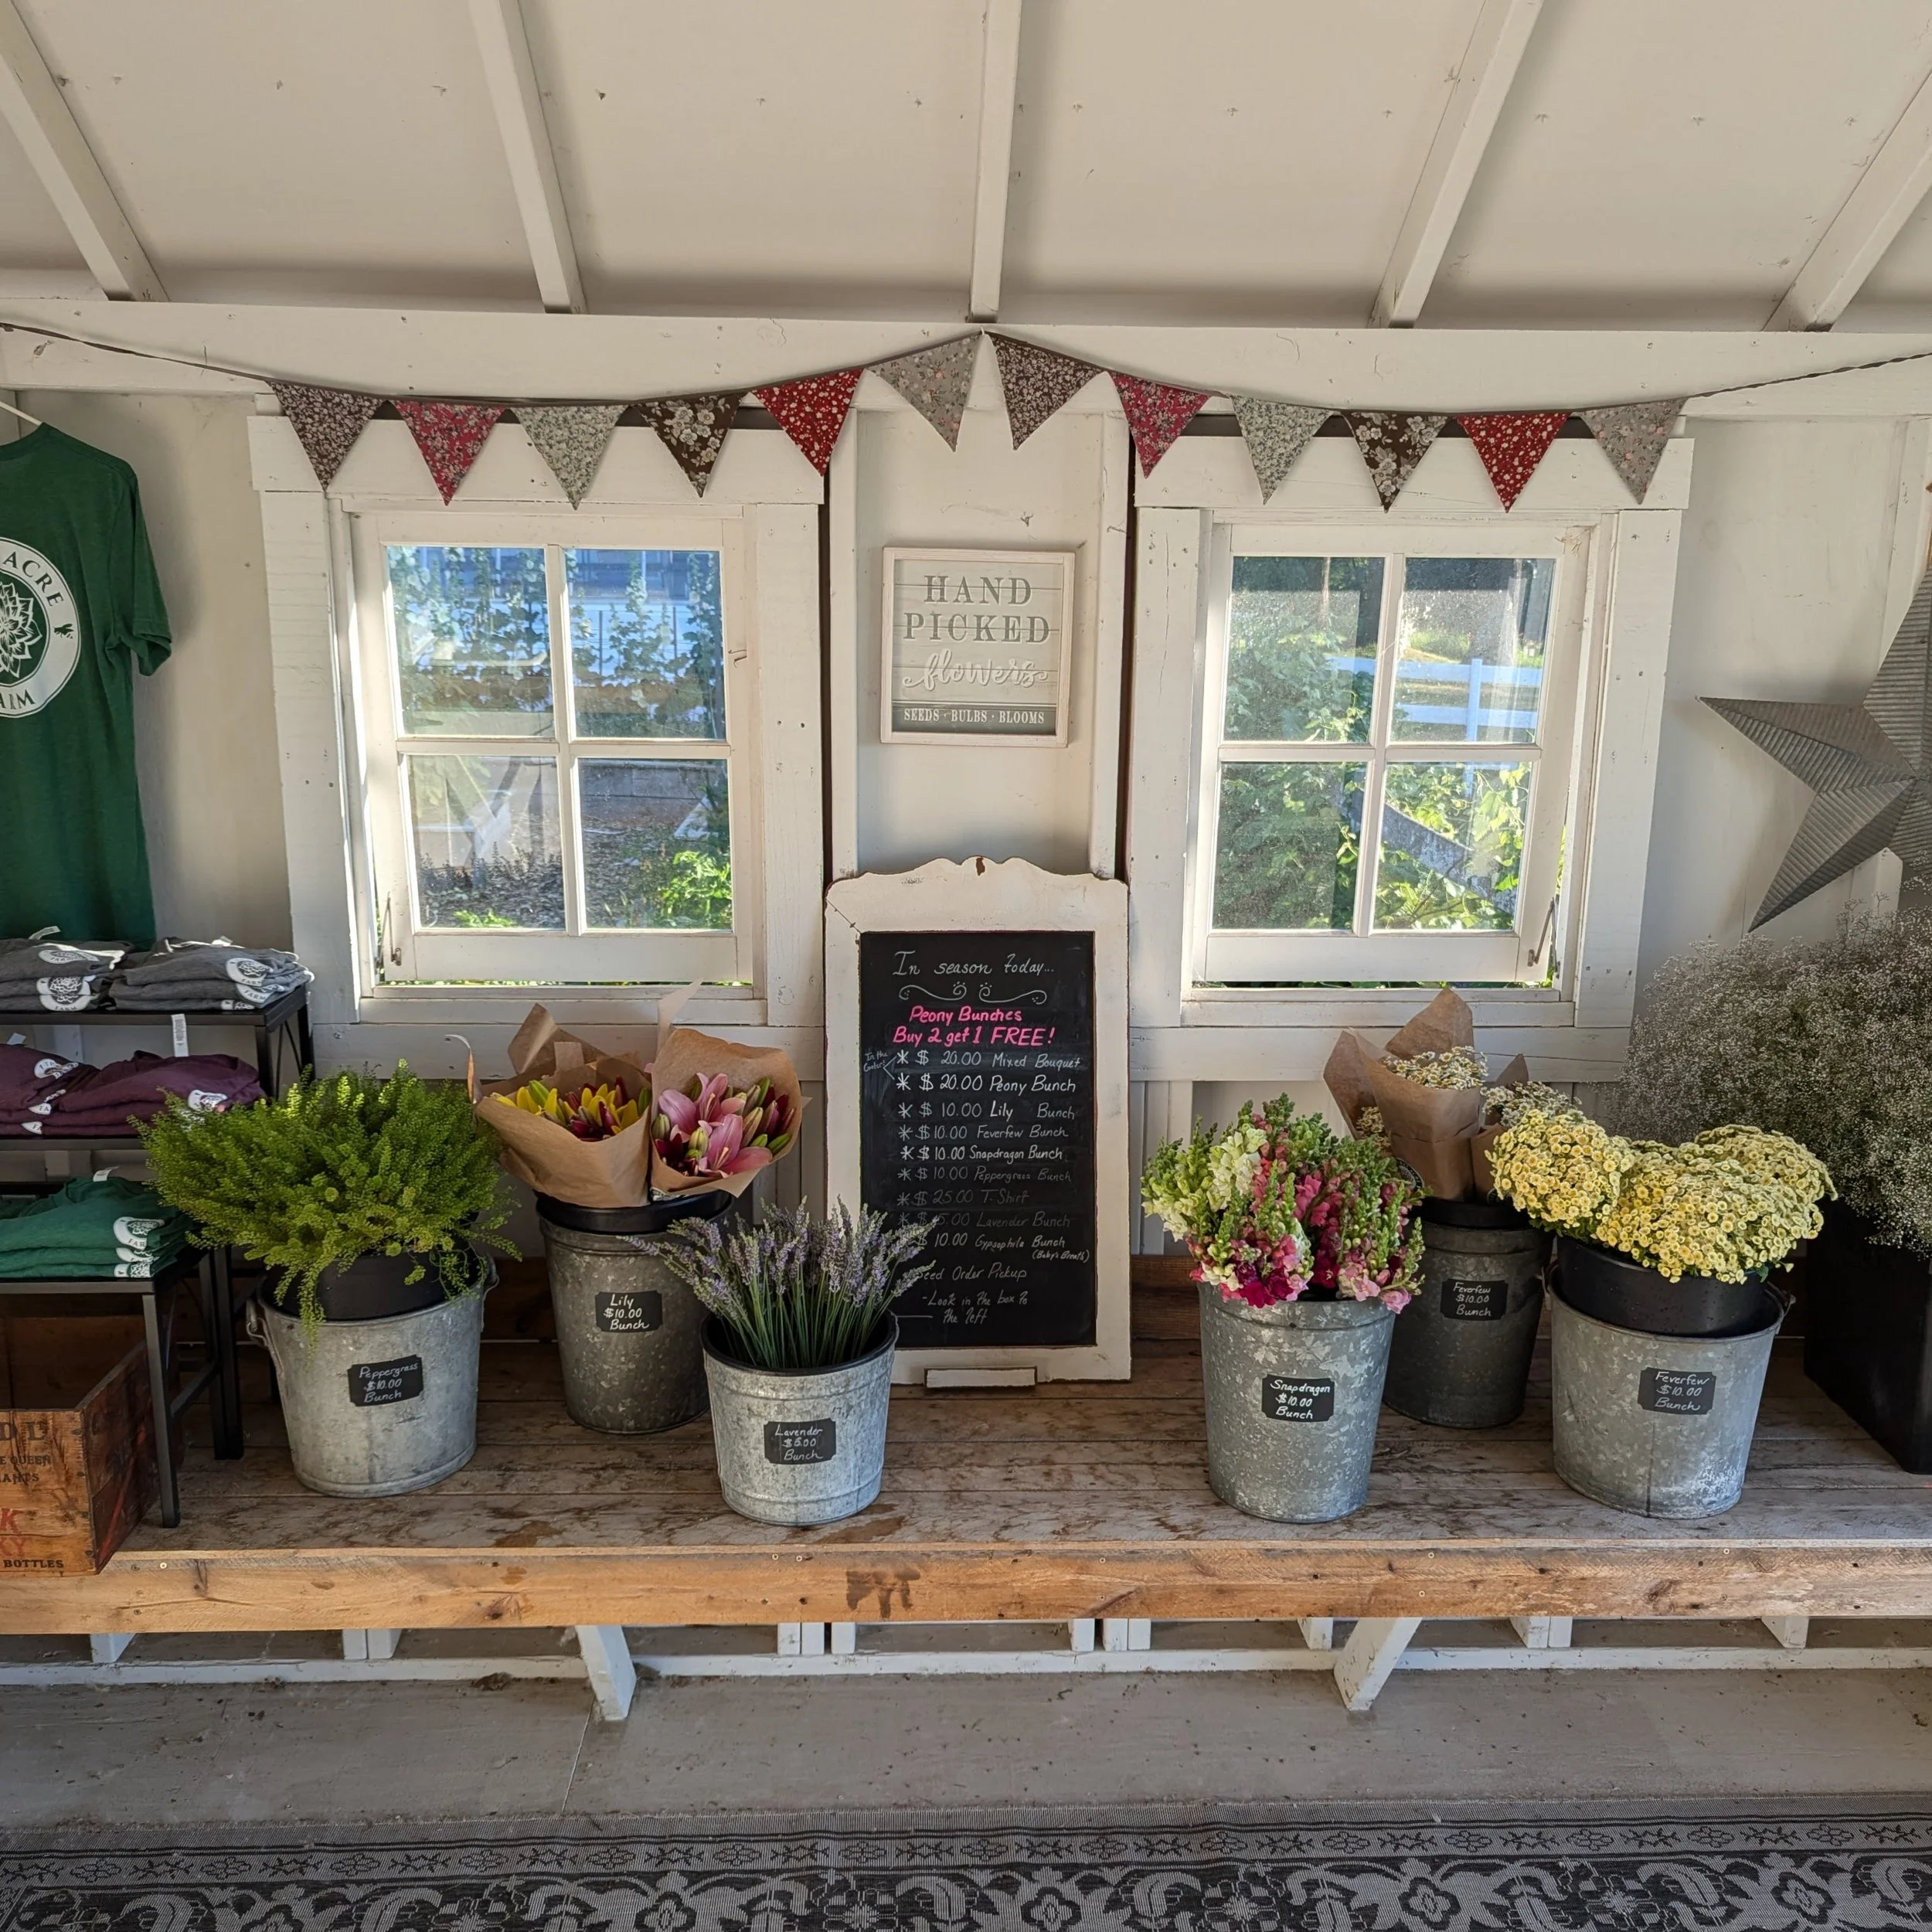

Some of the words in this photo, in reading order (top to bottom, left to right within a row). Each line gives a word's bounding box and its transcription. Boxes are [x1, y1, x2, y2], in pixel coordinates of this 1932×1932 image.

[2, 551, 65, 607] ACRE
[923, 575, 1032, 605] HAND
[903, 612, 1050, 643] PICKED
[903, 648, 1049, 692] flowers
[903, 708, 940, 722] SEEDS
[951, 709, 988, 723] BULBS
[998, 711, 1045, 725] BLOOMS
[893, 951, 920, 975] In
[934, 962, 993, 975] season
[910, 1005, 954, 1026] Peony
[958, 1005, 1023, 1022] Bunches
[893, 1026, 923, 1047] Buy
[927, 1027, 942, 1043] 2
[946, 1027, 970, 1047] get
[972, 1026, 982, 1043] 1
[991, 1027, 1056, 1046] FREE!
[992, 1052, 1027, 1068] Mixed
[1035, 1053, 1081, 1072] Bouquet
[989, 1075, 1027, 1096] Peony
[1031, 1075, 1077, 1092] Bunch
[990, 1100, 1014, 1122] Lily
[1037, 1102, 1076, 1120] Bunch
[977, 1124, 1024, 1139] Feverfew
[1029, 1124, 1069, 1138] Bunch
[969, 1145, 1024, 1165] Snapdragon
[1028, 1144, 1063, 1160] Bunch
[974, 1165, 1032, 1184] Peppergrass
[1037, 1168, 1072, 1182] Bunch
[976, 1212, 1029, 1228] Lavender
[1032, 1211, 1071, 1227] Bunch
[975, 1234, 1026, 1252] Gypsophila
[1031, 1235, 1066, 1249] Bunch
[1060, 1249, 1090, 1264] Breath)
[952, 1265, 985, 1281] Order
[988, 1261, 1028, 1283] Pickup
[1453, 1282, 1492, 1294] Feverfew
[611, 1294, 634, 1309] Lily
[962, 1297, 971, 1305] in
[977, 1291, 992, 1306] the
[997, 1288, 1015, 1304] box
[1019, 1291, 1029, 1305] to
[1455, 1294, 1489, 1304] $10.00
[604, 1308, 642, 1318] $10.00
[943, 1308, 958, 1324] the
[965, 1306, 988, 1325] left
[1456, 1304, 1492, 1317] Bunch
[610, 1318, 650, 1330] Bunch
[359, 1362, 419, 1380] Peppergrass
[1655, 1371, 1709, 1386] Feverfew
[363, 1378, 402, 1392] $10.00
[1270, 1379, 1331, 1396] Snapdragon
[1656, 1384, 1702, 1396] $10.00
[364, 1389, 402, 1403] Bunch
[1275, 1392, 1313, 1406] $10.00
[1655, 1396, 1701, 1411] Bunch
[1276, 1406, 1313, 1420] Bunch
[775, 1424, 823, 1436] Lavender
[784, 1448, 824, 1461] Bunch
[3, 1560, 64, 1569] BOTTLES
